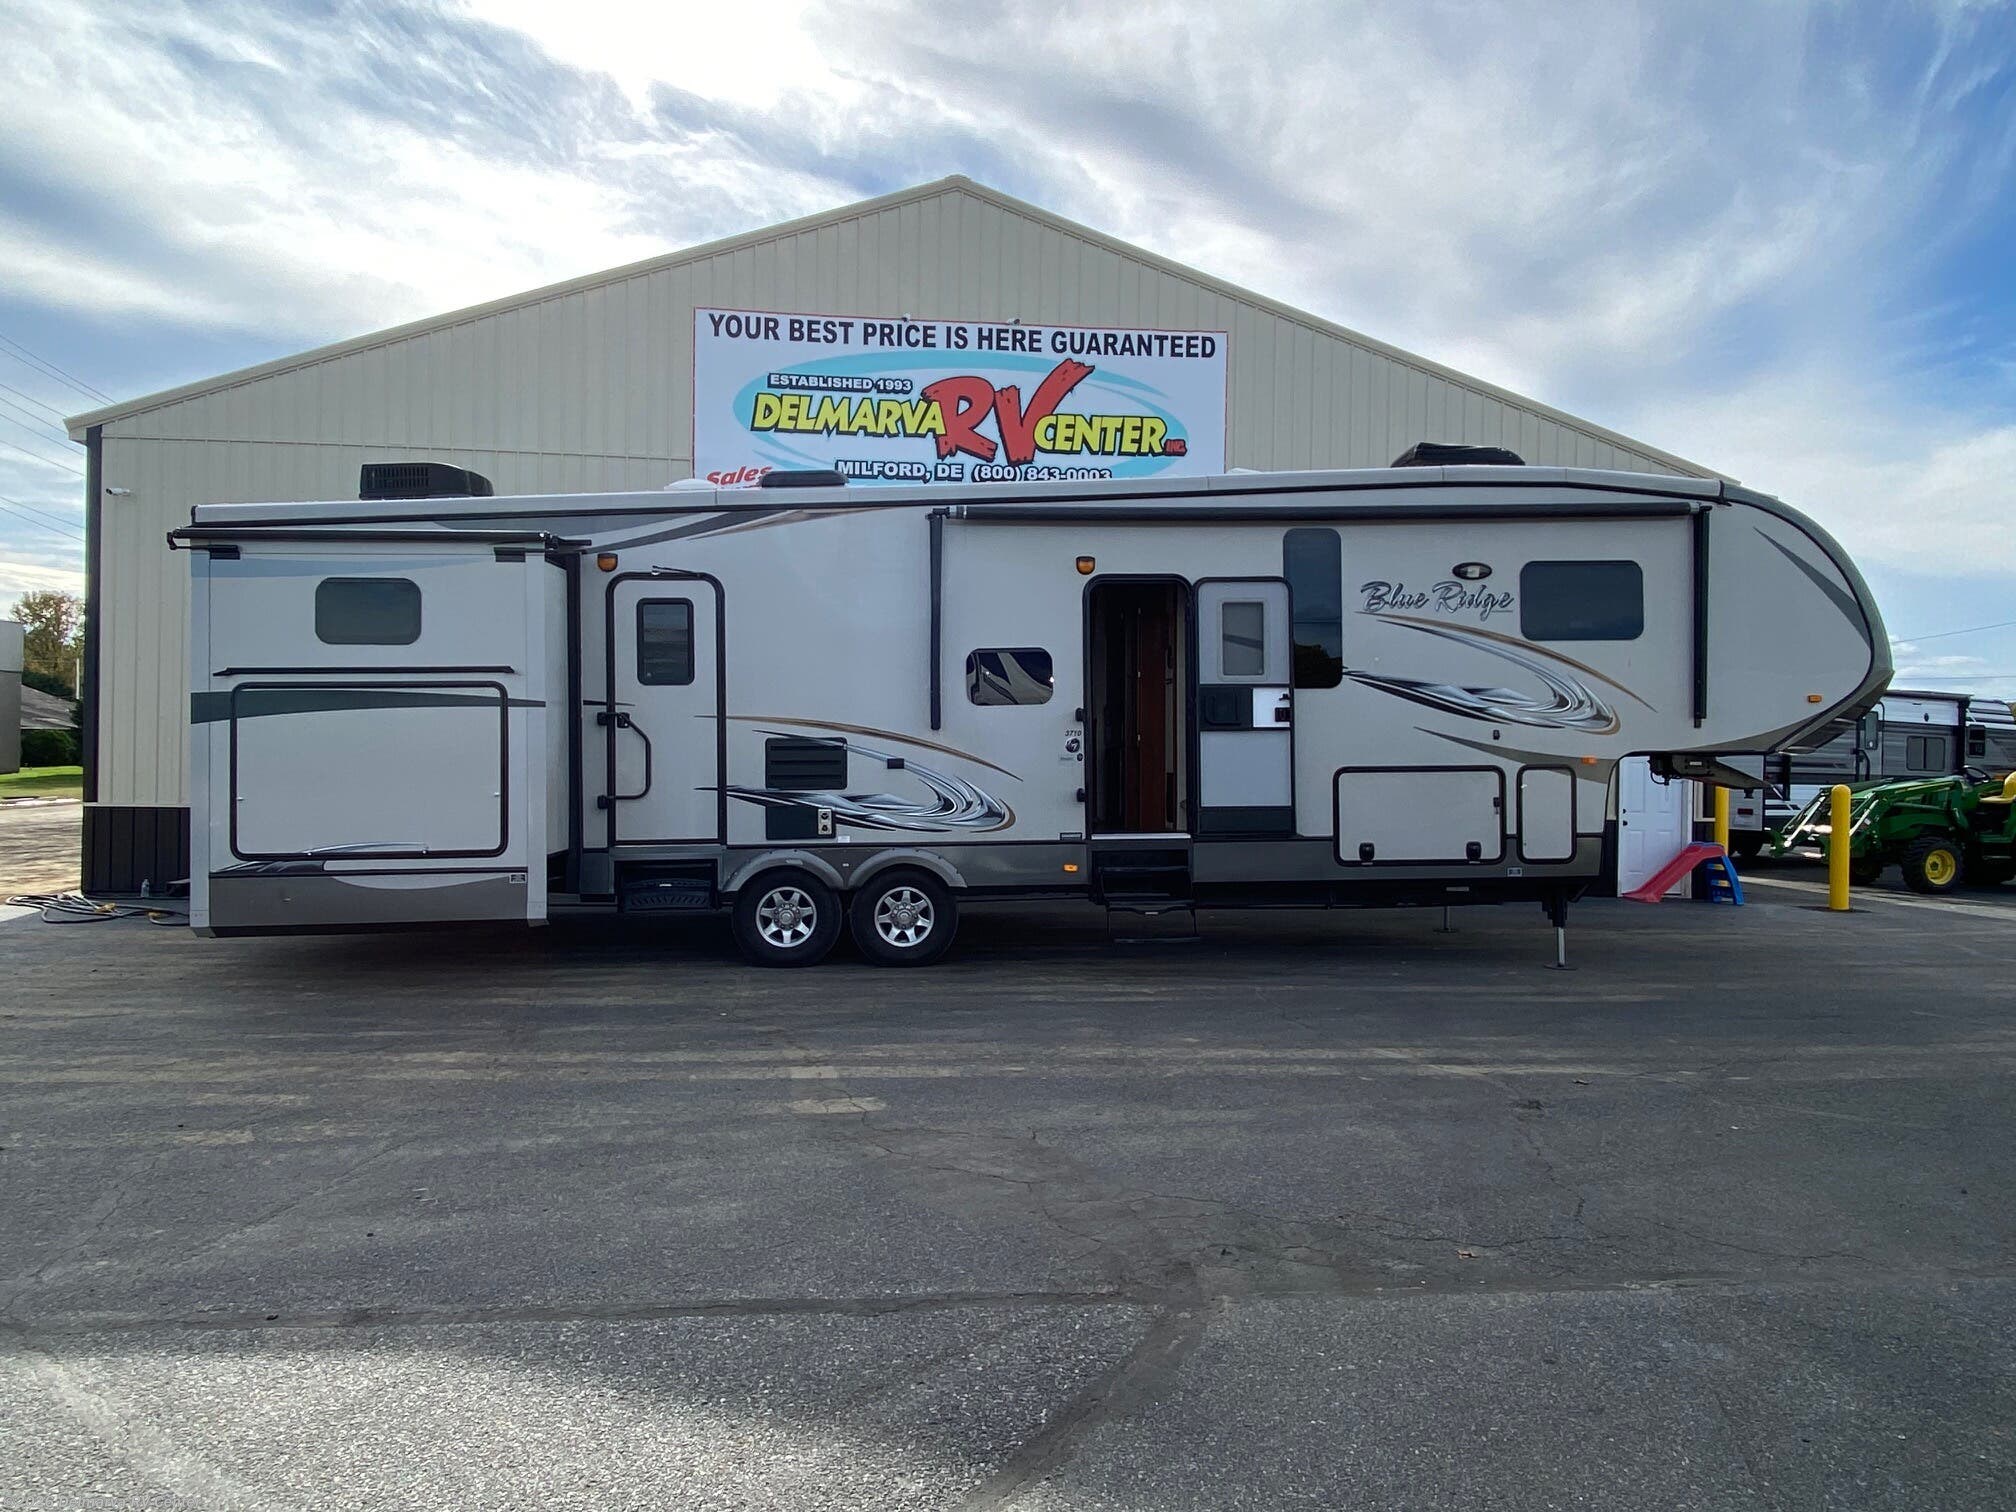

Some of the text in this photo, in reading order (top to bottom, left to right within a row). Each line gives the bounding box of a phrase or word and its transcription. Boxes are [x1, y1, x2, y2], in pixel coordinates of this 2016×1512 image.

[708, 313, 1216, 359] YOUR BEST PRICE IS HERE GUARANTEED
[769, 374, 912, 392] ESTABLISHED 1993
[752, 393, 947, 437] DELMARVA
[921, 358, 1095, 465] RV
[1033, 414, 1168, 454] CENTER
[837, 461, 931, 482] MILFORD,
[937, 464, 963, 479] DE
[973, 465, 1022, 482] (800)
[1360, 581, 1515, 622] Blue Ridge
